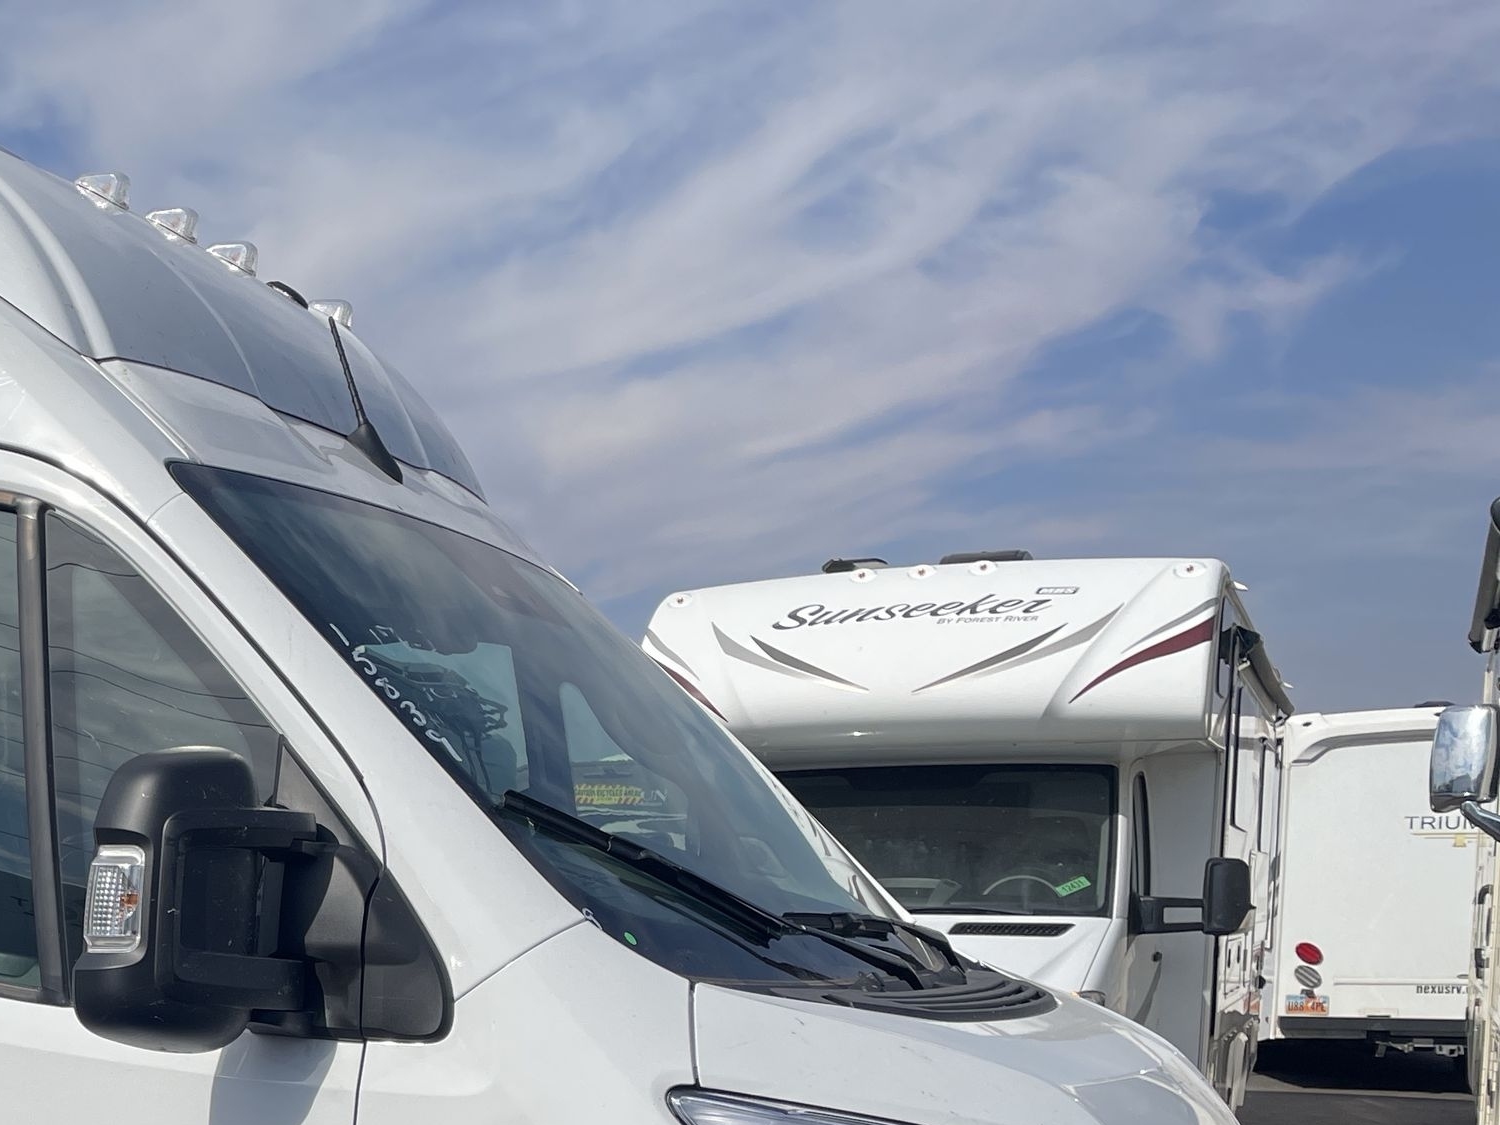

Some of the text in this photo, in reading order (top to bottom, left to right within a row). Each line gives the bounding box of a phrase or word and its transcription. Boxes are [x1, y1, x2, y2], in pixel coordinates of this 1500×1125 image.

[772, 593, 1052, 630] Sunseeker
[936, 617, 953, 625] BY
[1003, 615, 1040, 623] RIVER
